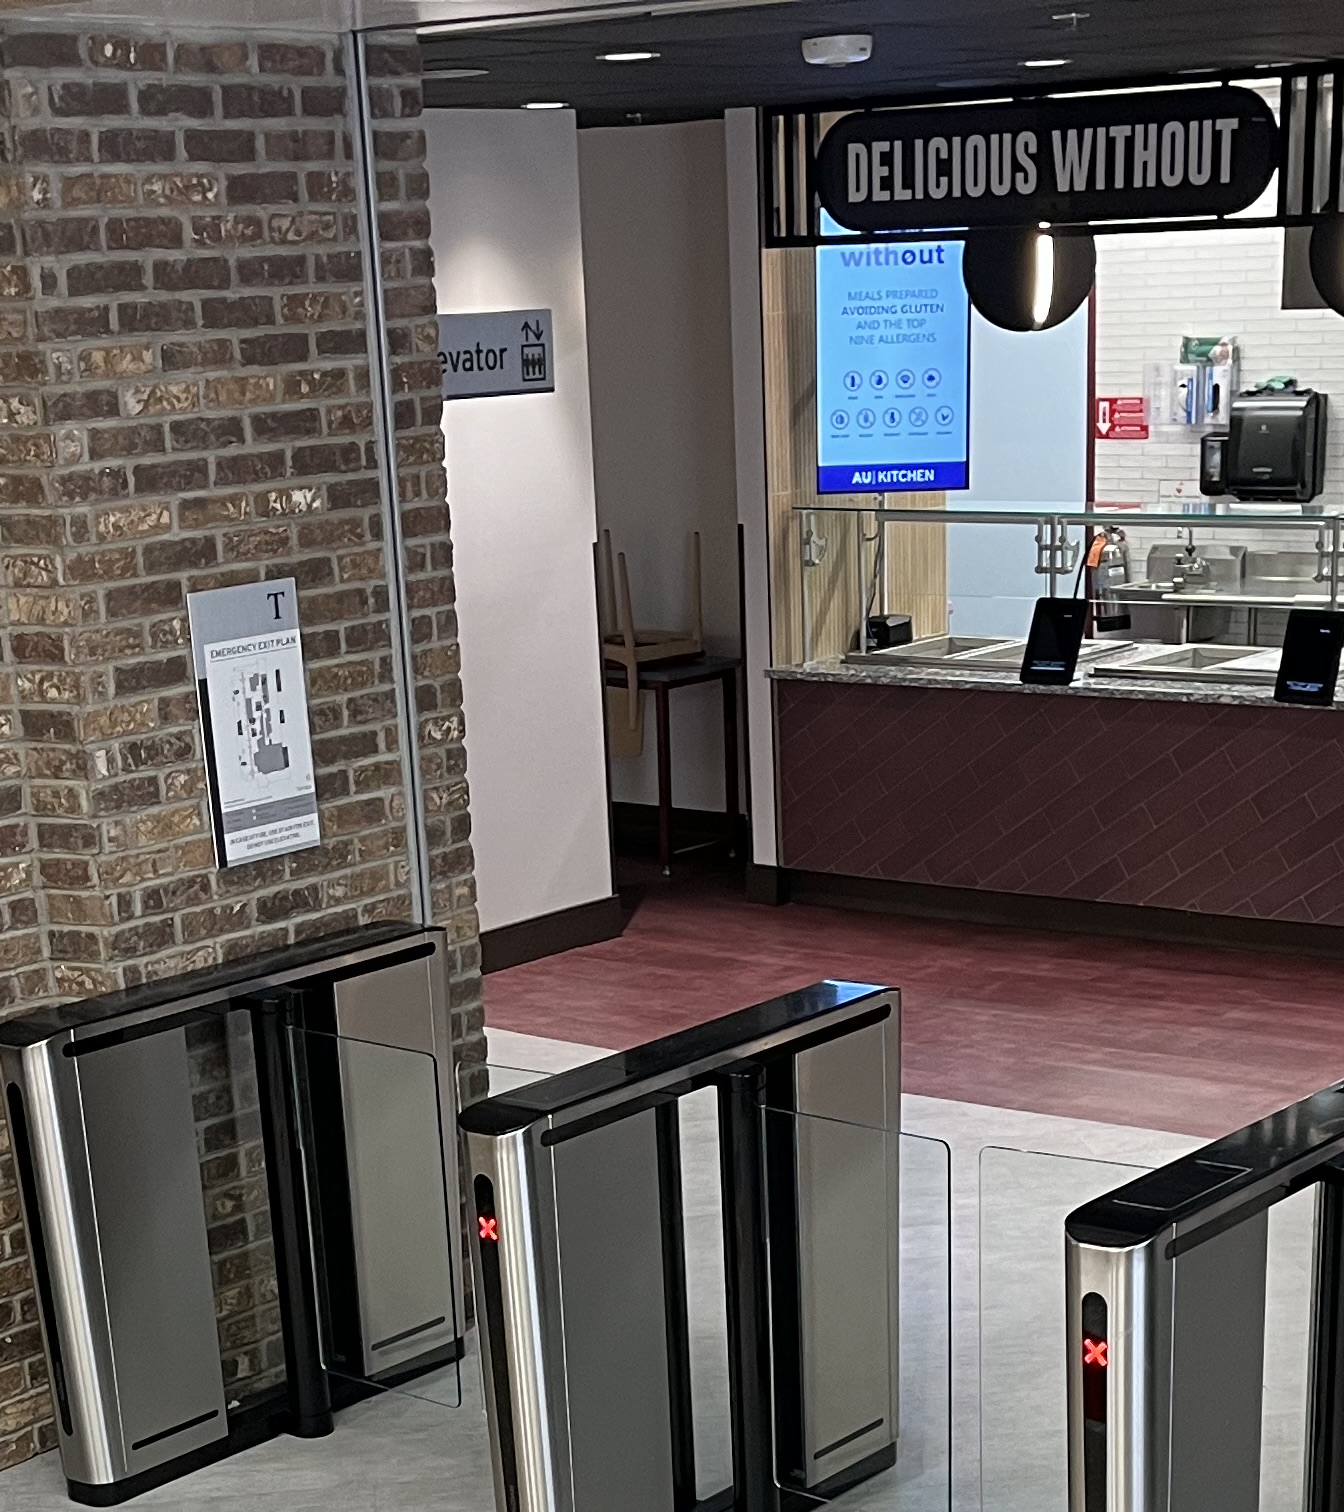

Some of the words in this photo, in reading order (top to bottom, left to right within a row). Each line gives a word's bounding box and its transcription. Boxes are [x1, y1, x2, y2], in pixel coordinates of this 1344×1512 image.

[847, 130, 1038, 203] DELICIOUS
[1051, 117, 1239, 192] WITHOUT
[847, 290, 883, 301] MEALS
[885, 288, 939, 300] PREPARED
[841, 305, 898, 316] AVOIDING
[900, 303, 945, 314] GLUTEN
[856, 320, 881, 330] AND
[883, 319, 903, 330] THE
[906, 318, 927, 329] TOP
[849, 335, 875, 345] NINE
[878, 332, 937, 344] ALLERGENS
[851, 471, 872, 484] AU
[877, 469, 935, 483] KITCHEN
[266, 591, 285, 620] T
[210, 642, 258, 659] EMERGENCY
[258, 639, 275, 650] EXIT
[275, 635, 297, 647] PLAN
